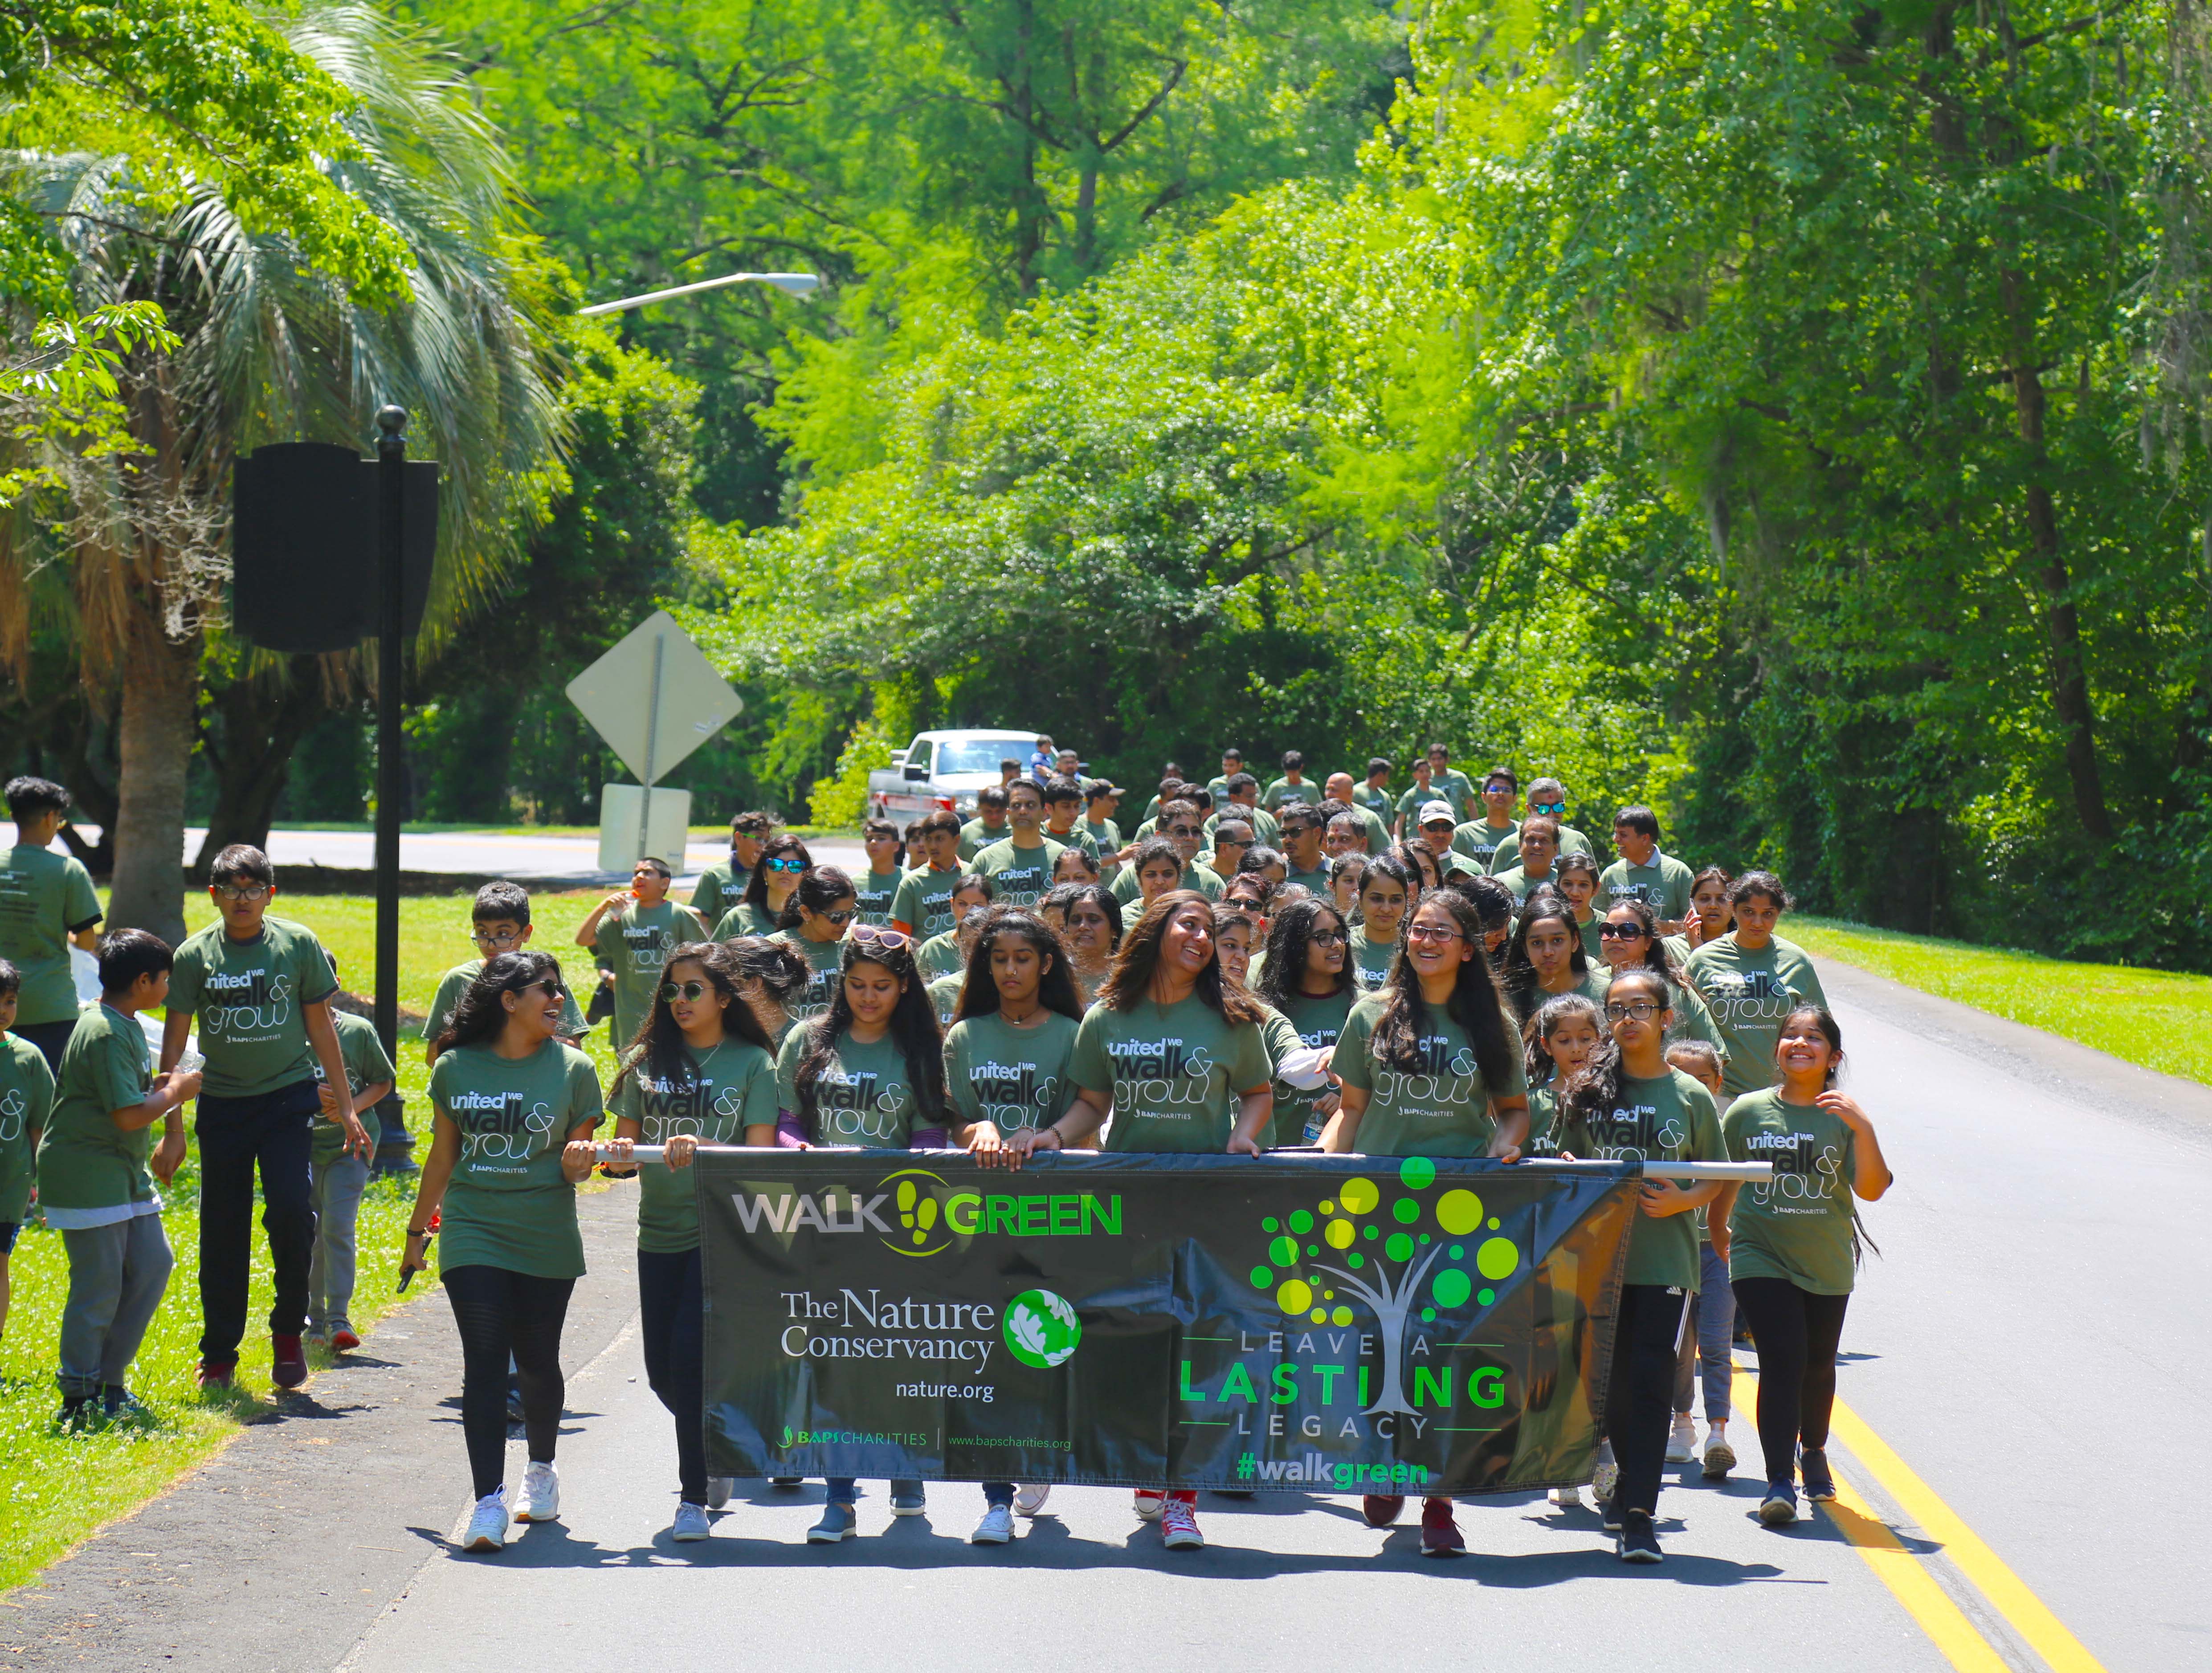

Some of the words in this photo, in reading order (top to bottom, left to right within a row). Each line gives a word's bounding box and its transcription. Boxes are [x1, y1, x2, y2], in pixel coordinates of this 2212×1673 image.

[1474, 843, 1496, 853] unite
[998, 867, 1032, 880] united
[721, 884, 744, 895] unite
[922, 889, 952, 904] united
[1609, 883, 1638, 894] united
[623, 926, 650, 937] nited
[251, 969, 265, 977] we
[269, 974, 291, 1001] &
[206, 1005, 289, 1034] grow
[1712, 998, 1791, 1025] grow
[1108, 1038, 1166, 1056] united
[1167, 1038, 1183, 1047] we
[1433, 1036, 1449, 1044] we
[969, 1060, 1021, 1081] united
[1022, 1062, 1037, 1071] we
[1111, 1046, 1195, 1080] walk
[1185, 1046, 1213, 1077] &
[1451, 1047, 1477, 1076] &
[700, 1079, 713, 1087] we
[970, 1071, 1042, 1107] walk
[1036, 1076, 1057, 1107] &
[1114, 1079, 1209, 1111] grow
[1375, 1073, 1474, 1106] grow
[451, 1091, 506, 1110] united
[507, 1092, 523, 1100] we
[714, 1087, 740, 1115] &
[877, 1083, 904, 1112] &
[1641, 1105, 1656, 1114] we
[525, 1102, 555, 1132] &
[1587, 1113, 1666, 1149] walk
[1658, 1119, 1685, 1148] &
[1746, 1131, 1798, 1150] united
[1800, 1132, 1815, 1141] we
[1816, 1145, 1841, 1174] &
[731, 1193, 894, 1233] WALK
[944, 1192, 1122, 1237] GREEN
[780, 1291, 838, 1319] The
[839, 1288, 995, 1331] Nature
[780, 1325, 995, 1375] Conservancy
[1241, 1331, 1374, 1355] LEAVE
[1410, 1336, 1430, 1356] A
[895, 1380, 995, 1403] nature.org
[1179, 1360, 1505, 1409] LASTING
[1237, 1414, 1428, 1440] LEGACY
[948, 1433, 1072, 1452] www.bapscharities.org
[1237, 1452, 1429, 1490] #walkgreen
